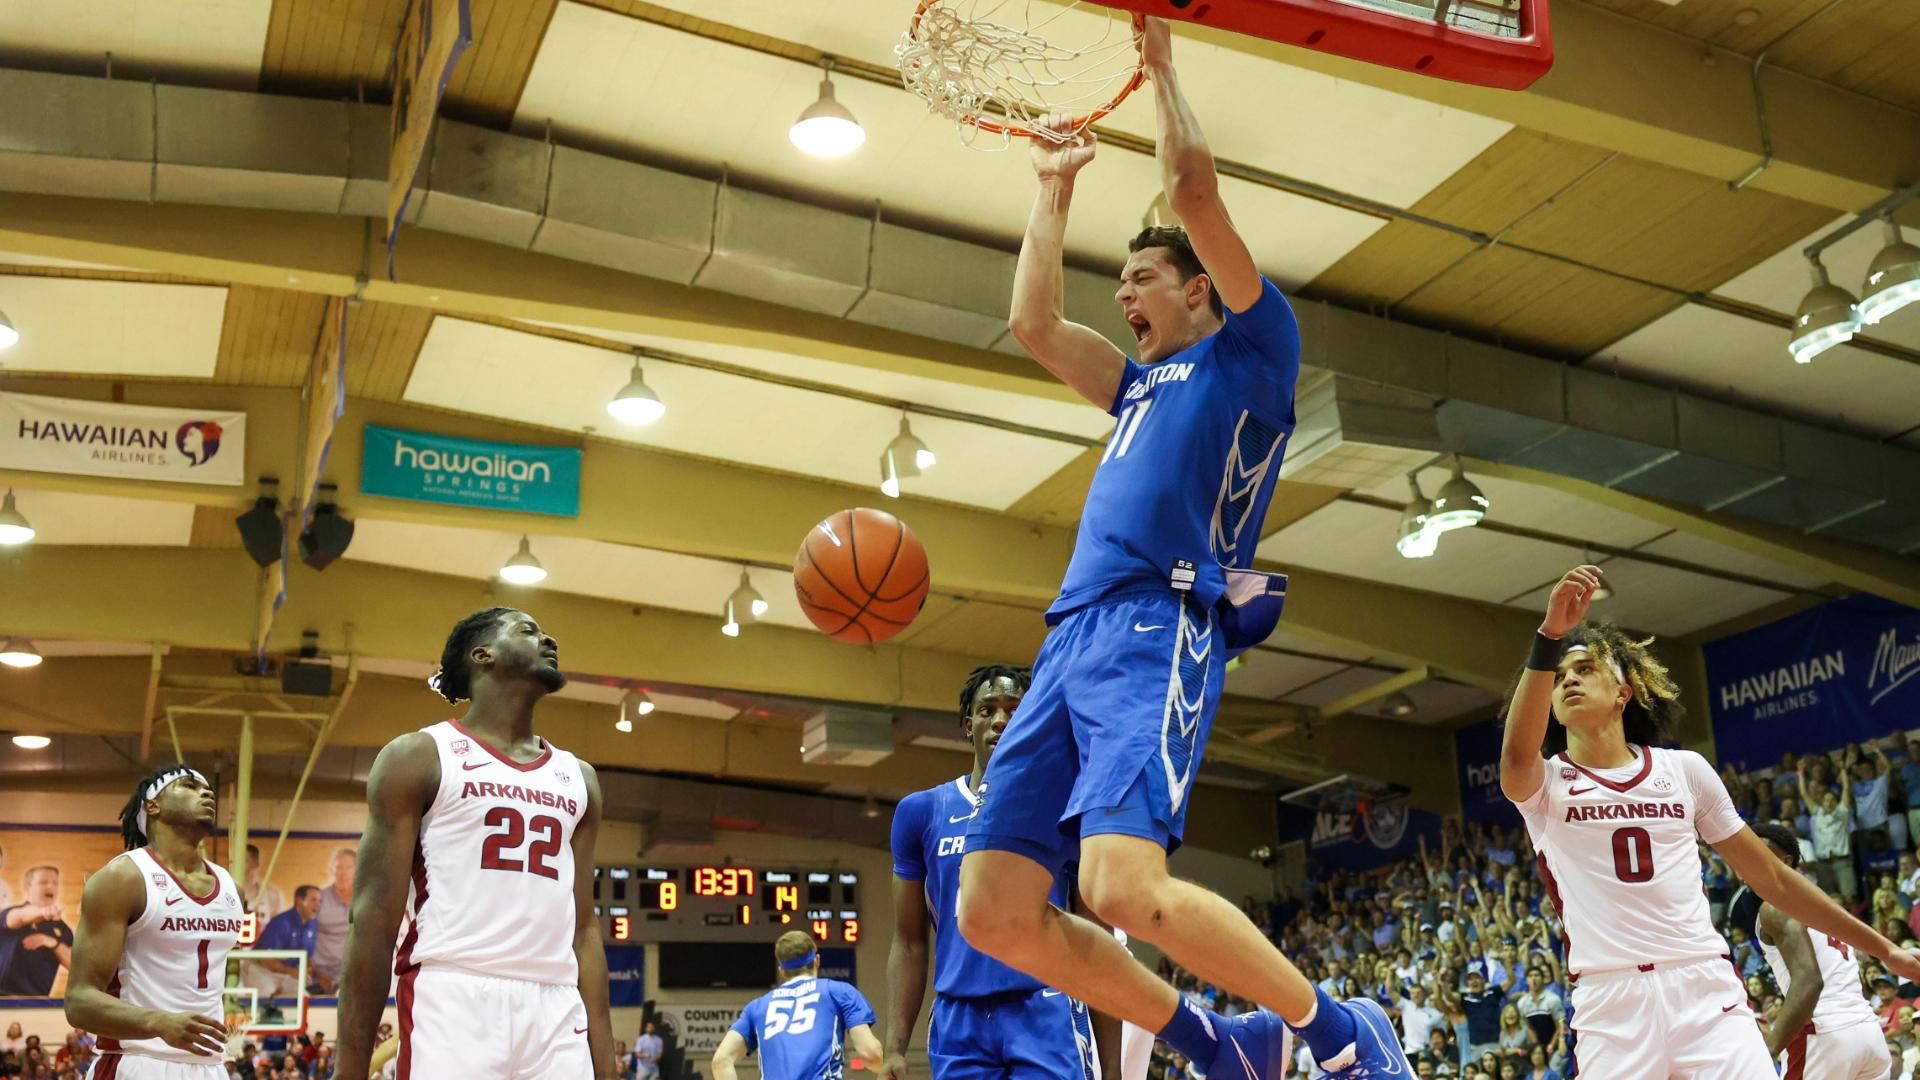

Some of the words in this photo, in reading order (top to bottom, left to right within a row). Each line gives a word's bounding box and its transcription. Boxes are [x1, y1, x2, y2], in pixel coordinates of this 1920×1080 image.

[18, 419, 168, 449] HAWAIIAN
[1101, 399, 1153, 466] 11
[92, 450, 166, 466] AIRLINES
[395, 440, 550, 483] hawaiian
[424, 473, 521, 494] SPRINGS
[1178, 560, 1193, 569] 52
[1721, 651, 1846, 711] HAWAIIAN
[1754, 690, 1819, 721] AIRLINES
[461, 781, 577, 816] ARKANSAS
[1565, 803, 1685, 822] ARKANSAS
[480, 806, 563, 881] 22
[1611, 827, 1654, 883] 0
[694, 868, 753, 896] 13:37
[659, 882, 677, 910] 8
[776, 886, 798, 911] 14
[160, 917, 242, 932] ARKANSAS
[743, 905, 750, 925] 1
[615, 917, 629, 940] 3
[813, 921, 828, 941] 4
[844, 920, 858, 942] 2
[197, 939, 210, 989] 1
[684, 1010, 735, 1021] COUNTY
[764, 993, 820, 1040] 55
[687, 1026, 716, 1034] Parks
